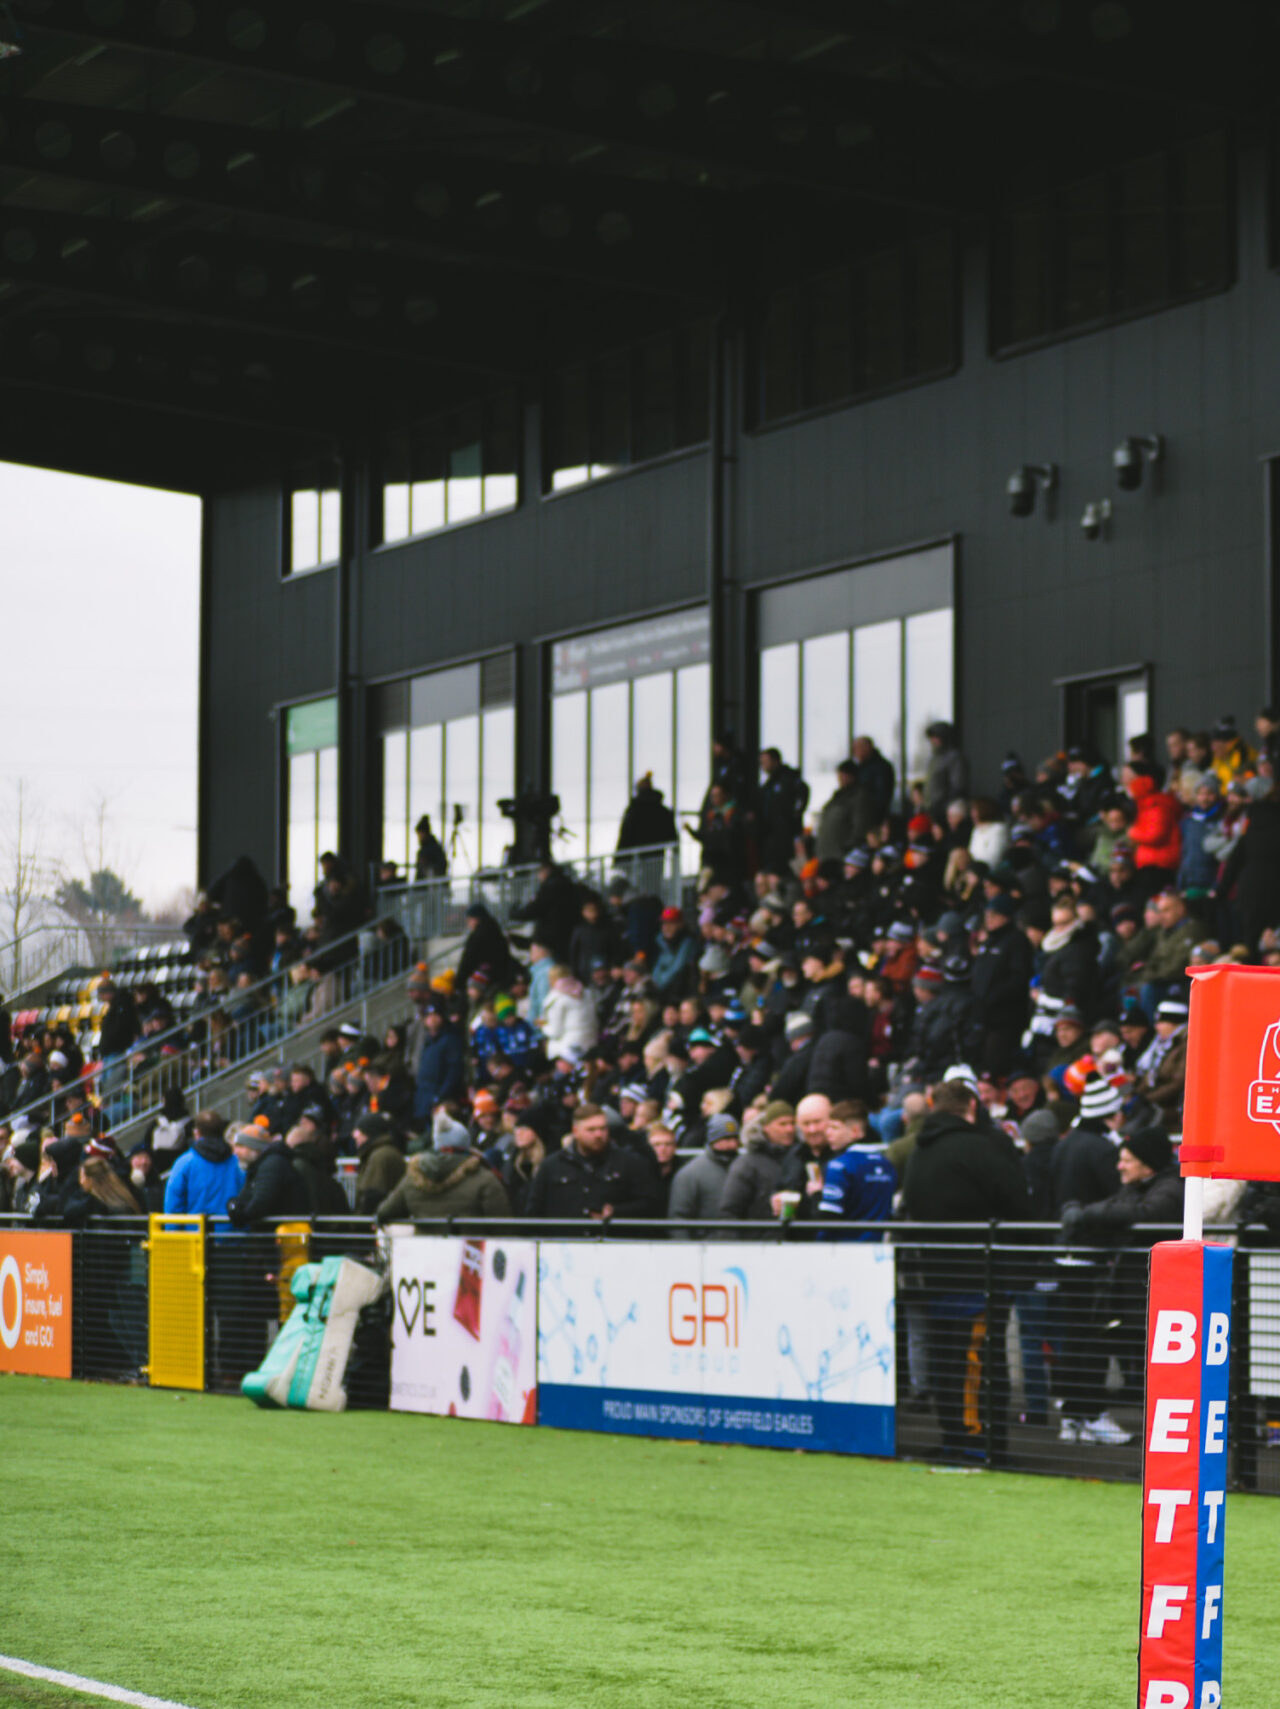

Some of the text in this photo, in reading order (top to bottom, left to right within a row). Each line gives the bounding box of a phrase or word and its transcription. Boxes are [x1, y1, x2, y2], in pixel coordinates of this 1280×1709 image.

[668, 1282, 739, 1348] GRI
[603, 1400, 814, 1435] PROUD MAIN SPONSORS OF SHEFFIELD EAGLES
